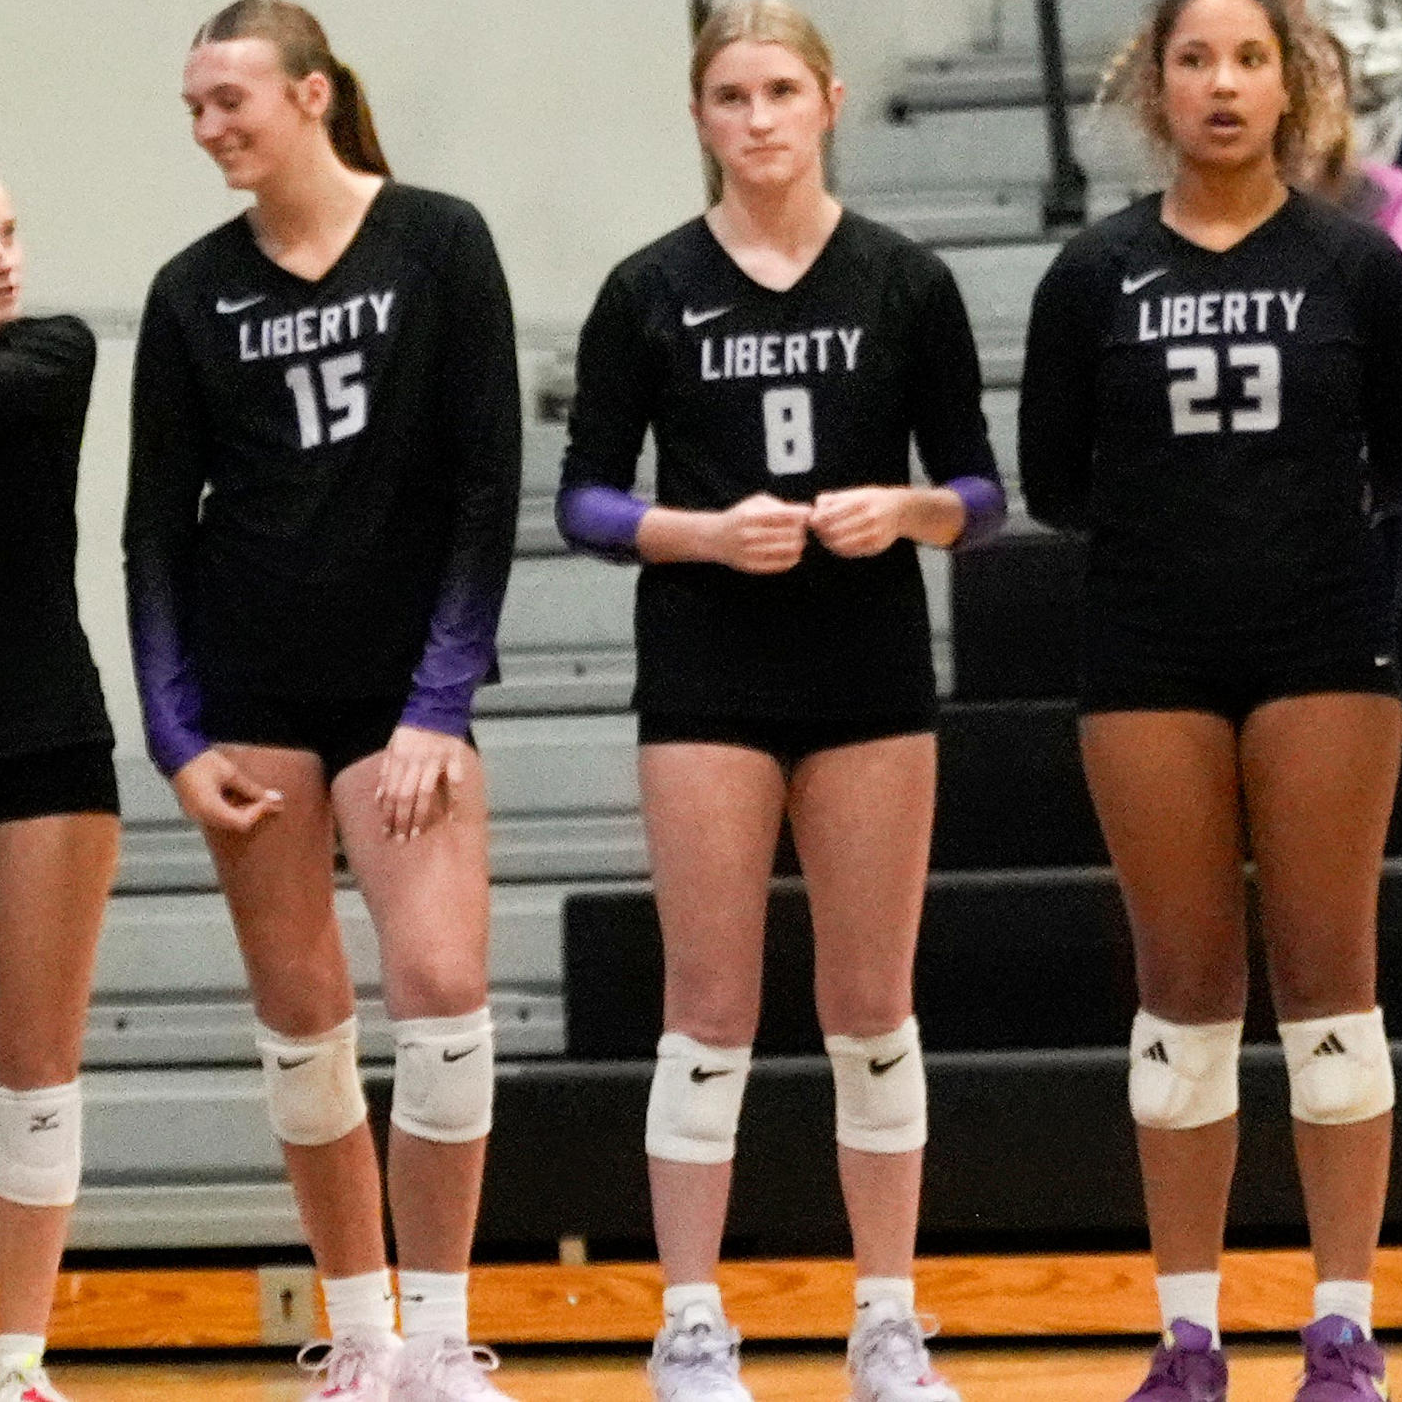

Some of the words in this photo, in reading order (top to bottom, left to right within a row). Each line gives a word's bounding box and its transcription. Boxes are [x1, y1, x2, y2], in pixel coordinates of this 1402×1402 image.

[238, 291, 395, 362] LIBERTY
[700, 327, 863, 381] LIBERTY
[1138, 288, 1305, 342] LIBERTY
[283, 351, 367, 449] 15
[1165, 343, 1283, 436] 23
[762, 386, 815, 477] 8
